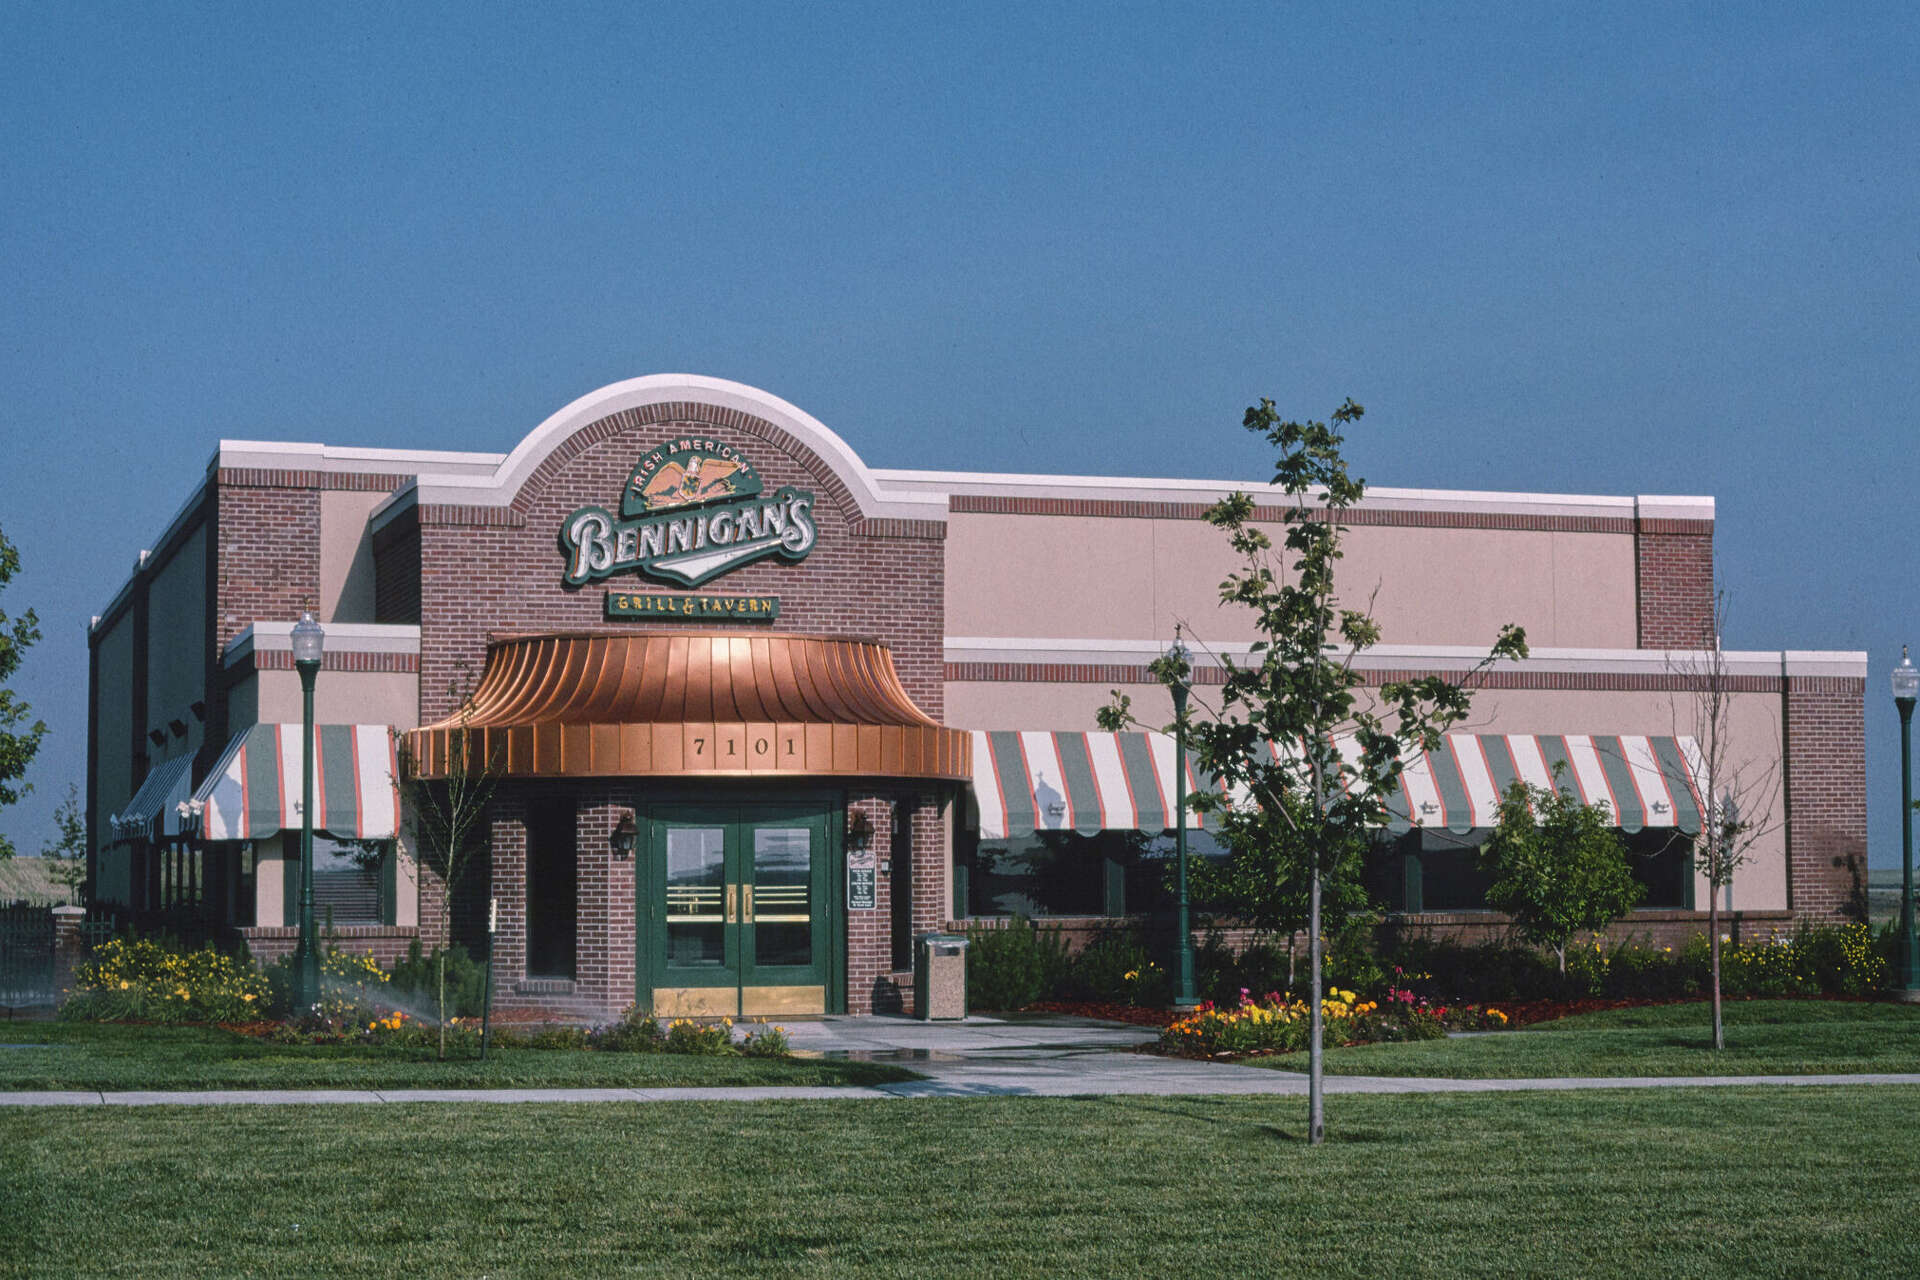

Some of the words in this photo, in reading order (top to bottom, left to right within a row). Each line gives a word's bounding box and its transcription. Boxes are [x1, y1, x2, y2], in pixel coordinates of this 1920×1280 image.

[630, 452, 663, 492] IRISH
[668, 440, 749, 473] AMERICAN
[570, 491, 814, 578] BENNIGAN'S
[618, 597, 676, 611] GRILL
[682, 598, 695, 615] &
[700, 598, 772, 612] TAVERN
[693, 738, 795, 755] 7101
